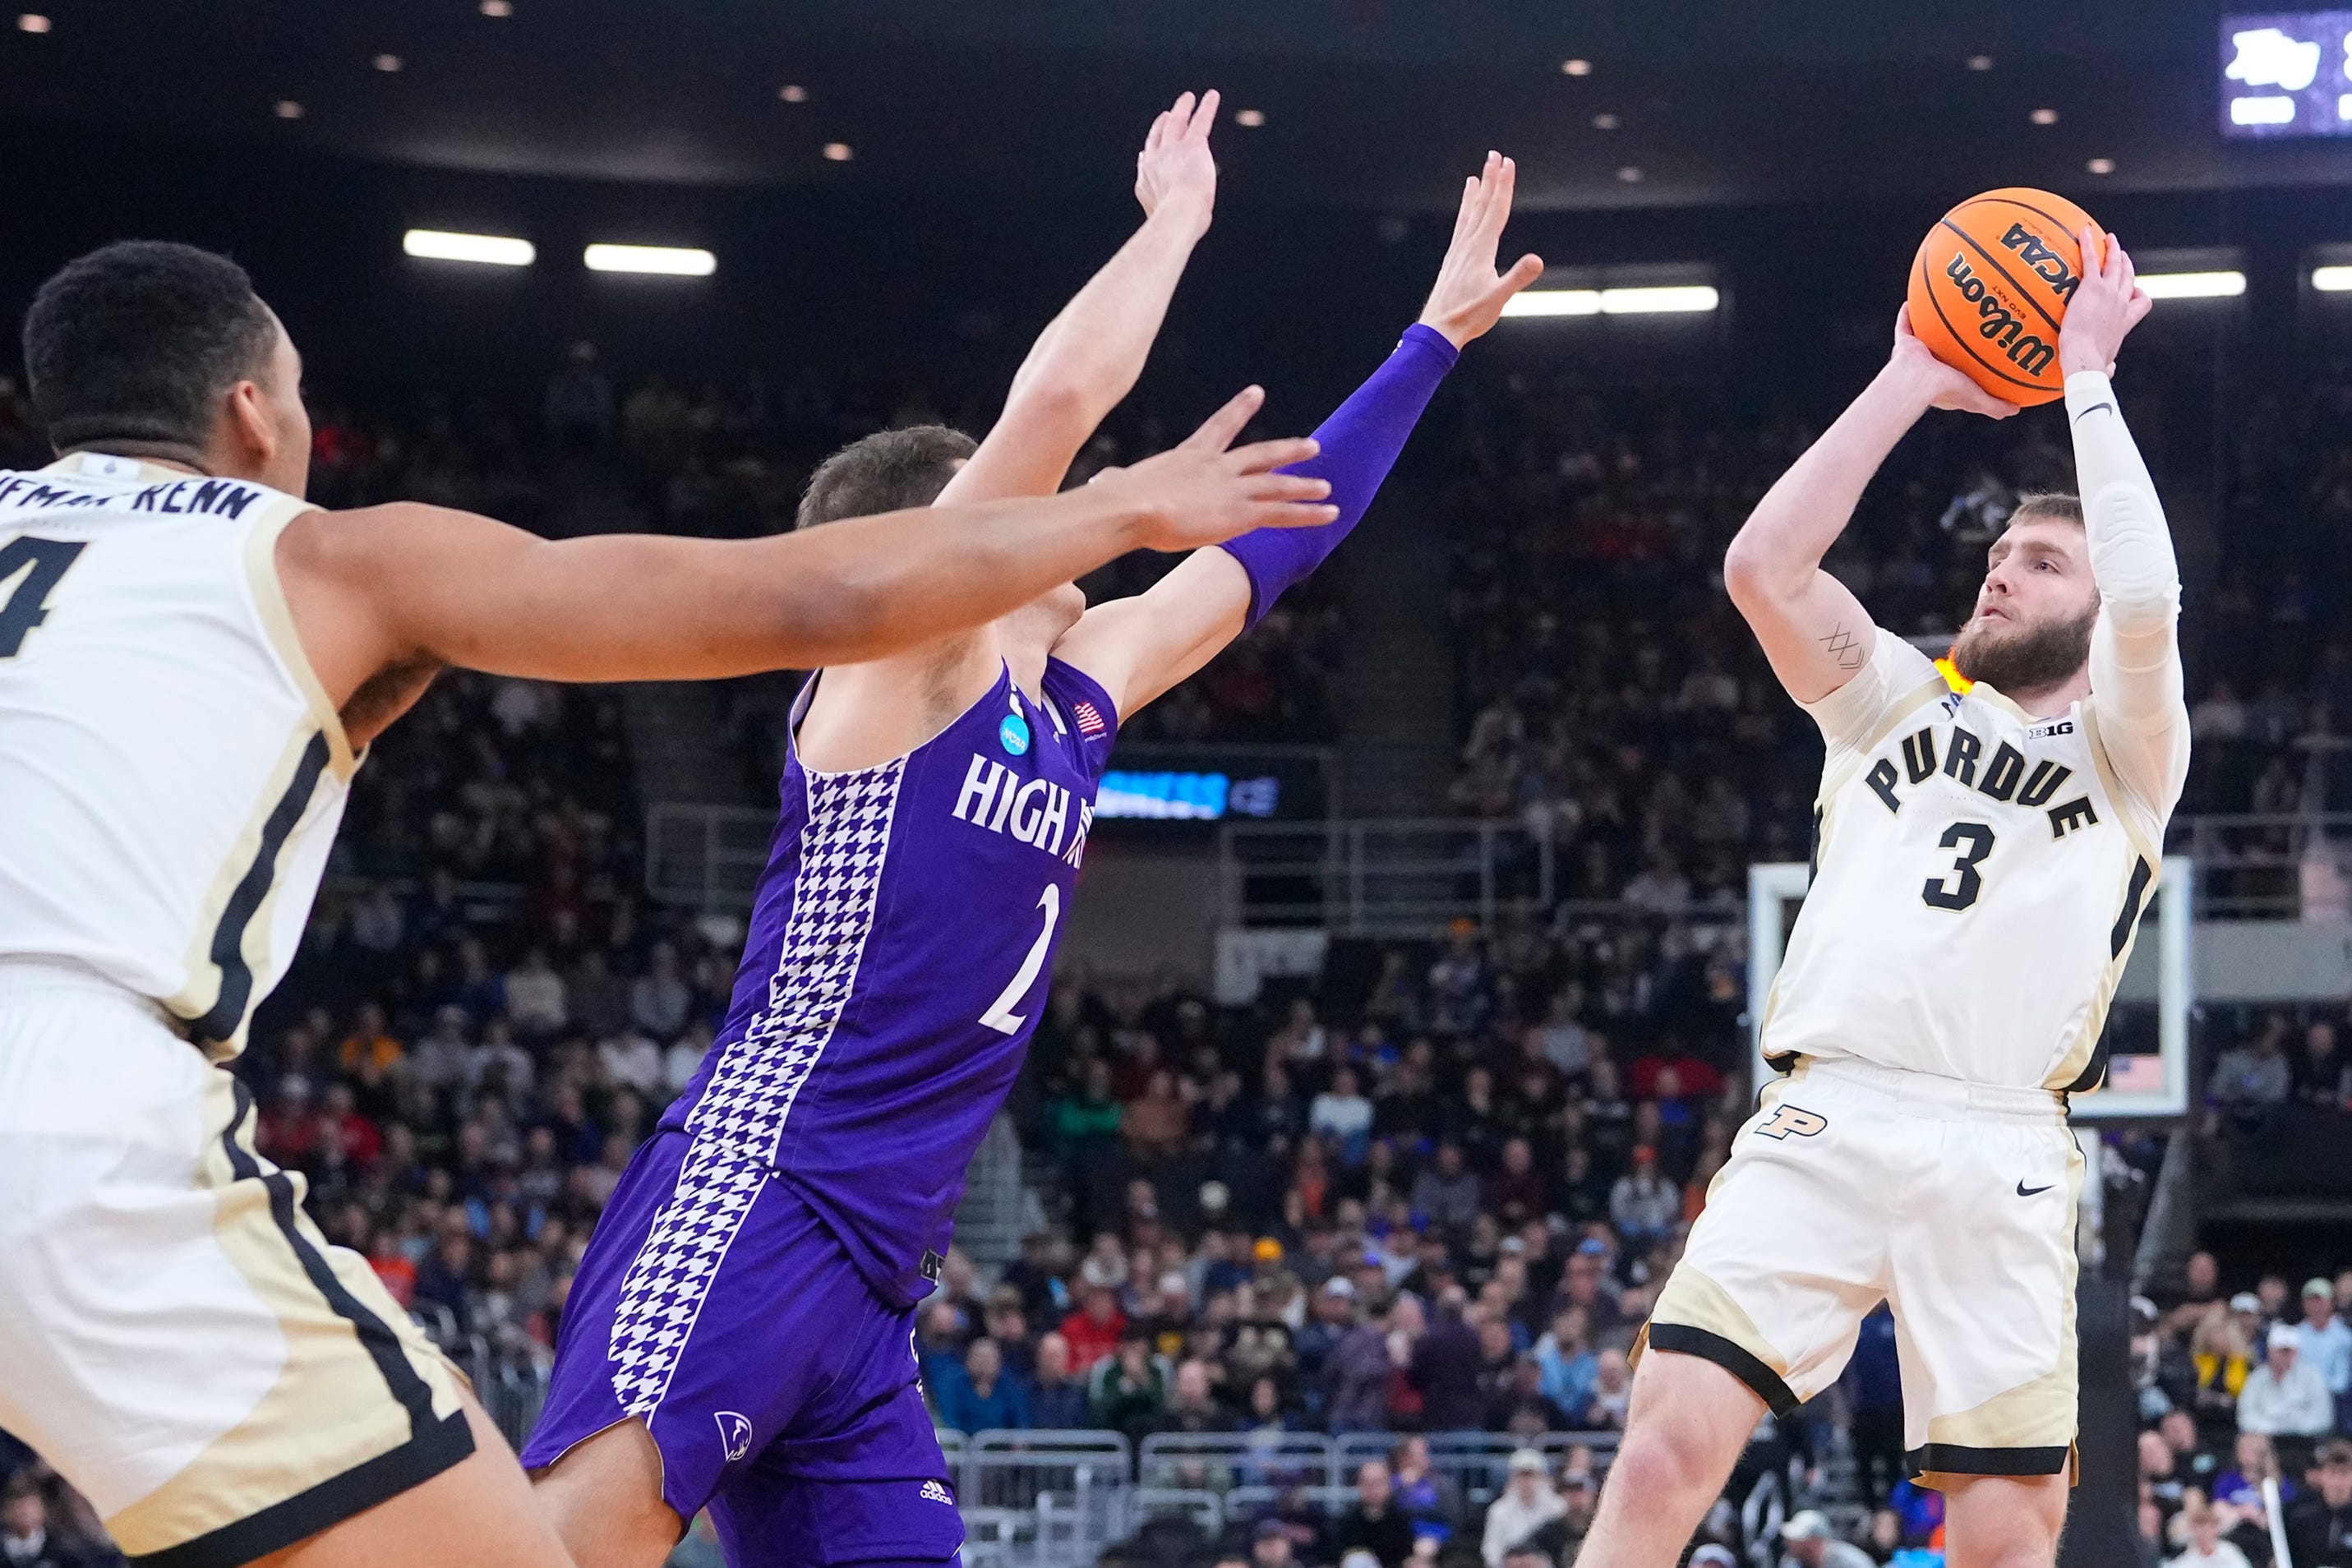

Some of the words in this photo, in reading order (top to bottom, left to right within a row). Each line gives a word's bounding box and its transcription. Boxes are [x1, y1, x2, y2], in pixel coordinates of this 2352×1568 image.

[2000, 223, 2081, 307] NCAA
[1946, 251, 2055, 377] Wilson
[0, 534, 90, 660] 4
[1003, 727, 1026, 751] NCAA
[1863, 725, 2102, 842] PURDUE
[951, 753, 1070, 856] HIGH
[1921, 821, 1997, 912] 3
[978, 883, 1060, 1036] 2
[1754, 1104, 1829, 1141] P
[920, 1489, 953, 1506] adidas
